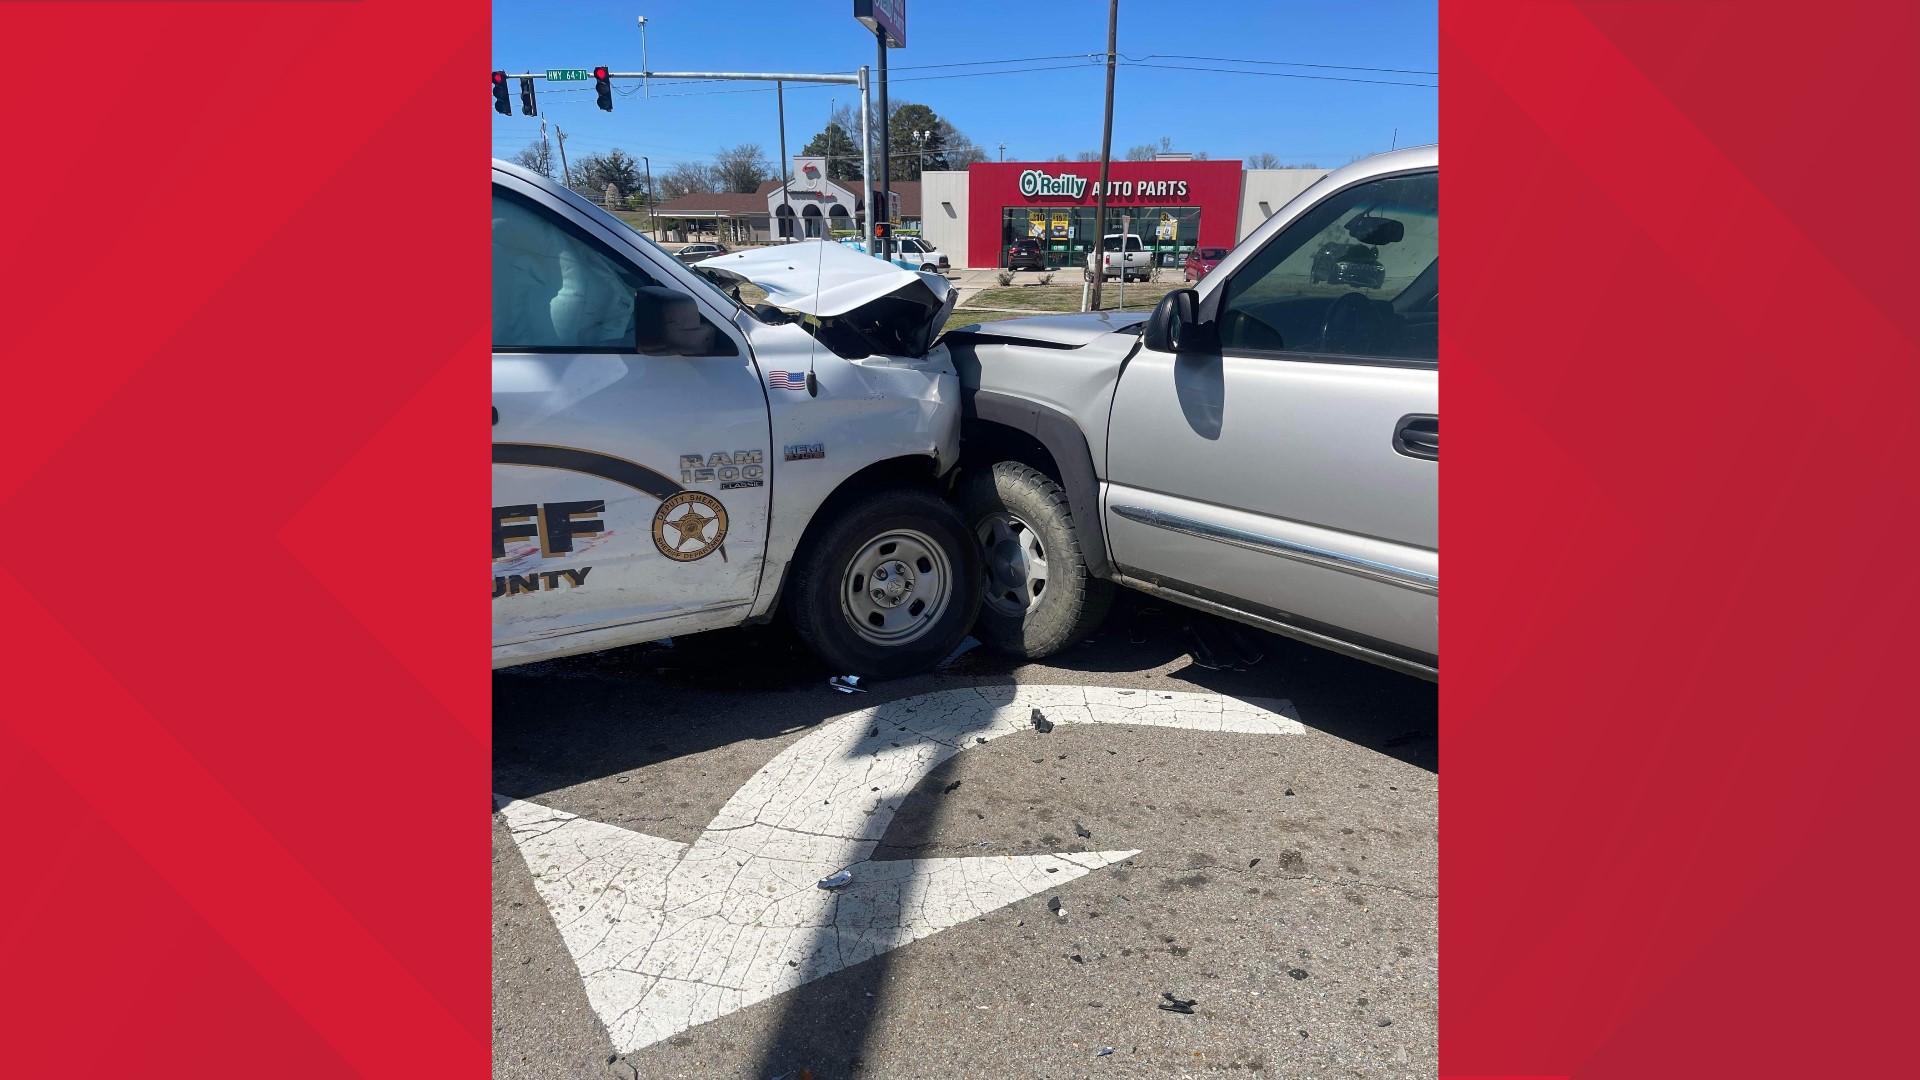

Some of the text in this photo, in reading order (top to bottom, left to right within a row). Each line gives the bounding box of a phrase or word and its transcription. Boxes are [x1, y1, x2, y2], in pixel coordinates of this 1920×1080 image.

[548, 70, 586, 80] HWY 64-71
[1019, 169, 1087, 198] O'Reilly
[1137, 180, 1187, 196] PARTS
[784, 443, 824, 455] HEMI
[680, 450, 763, 469] RAM
[681, 465, 764, 483] 1500
[721, 480, 763, 490] CLASSIC
[658, 494, 723, 521] DEPUTY SHERIFF
[656, 529, 725, 559] SHERIFF DEPARTMENT
